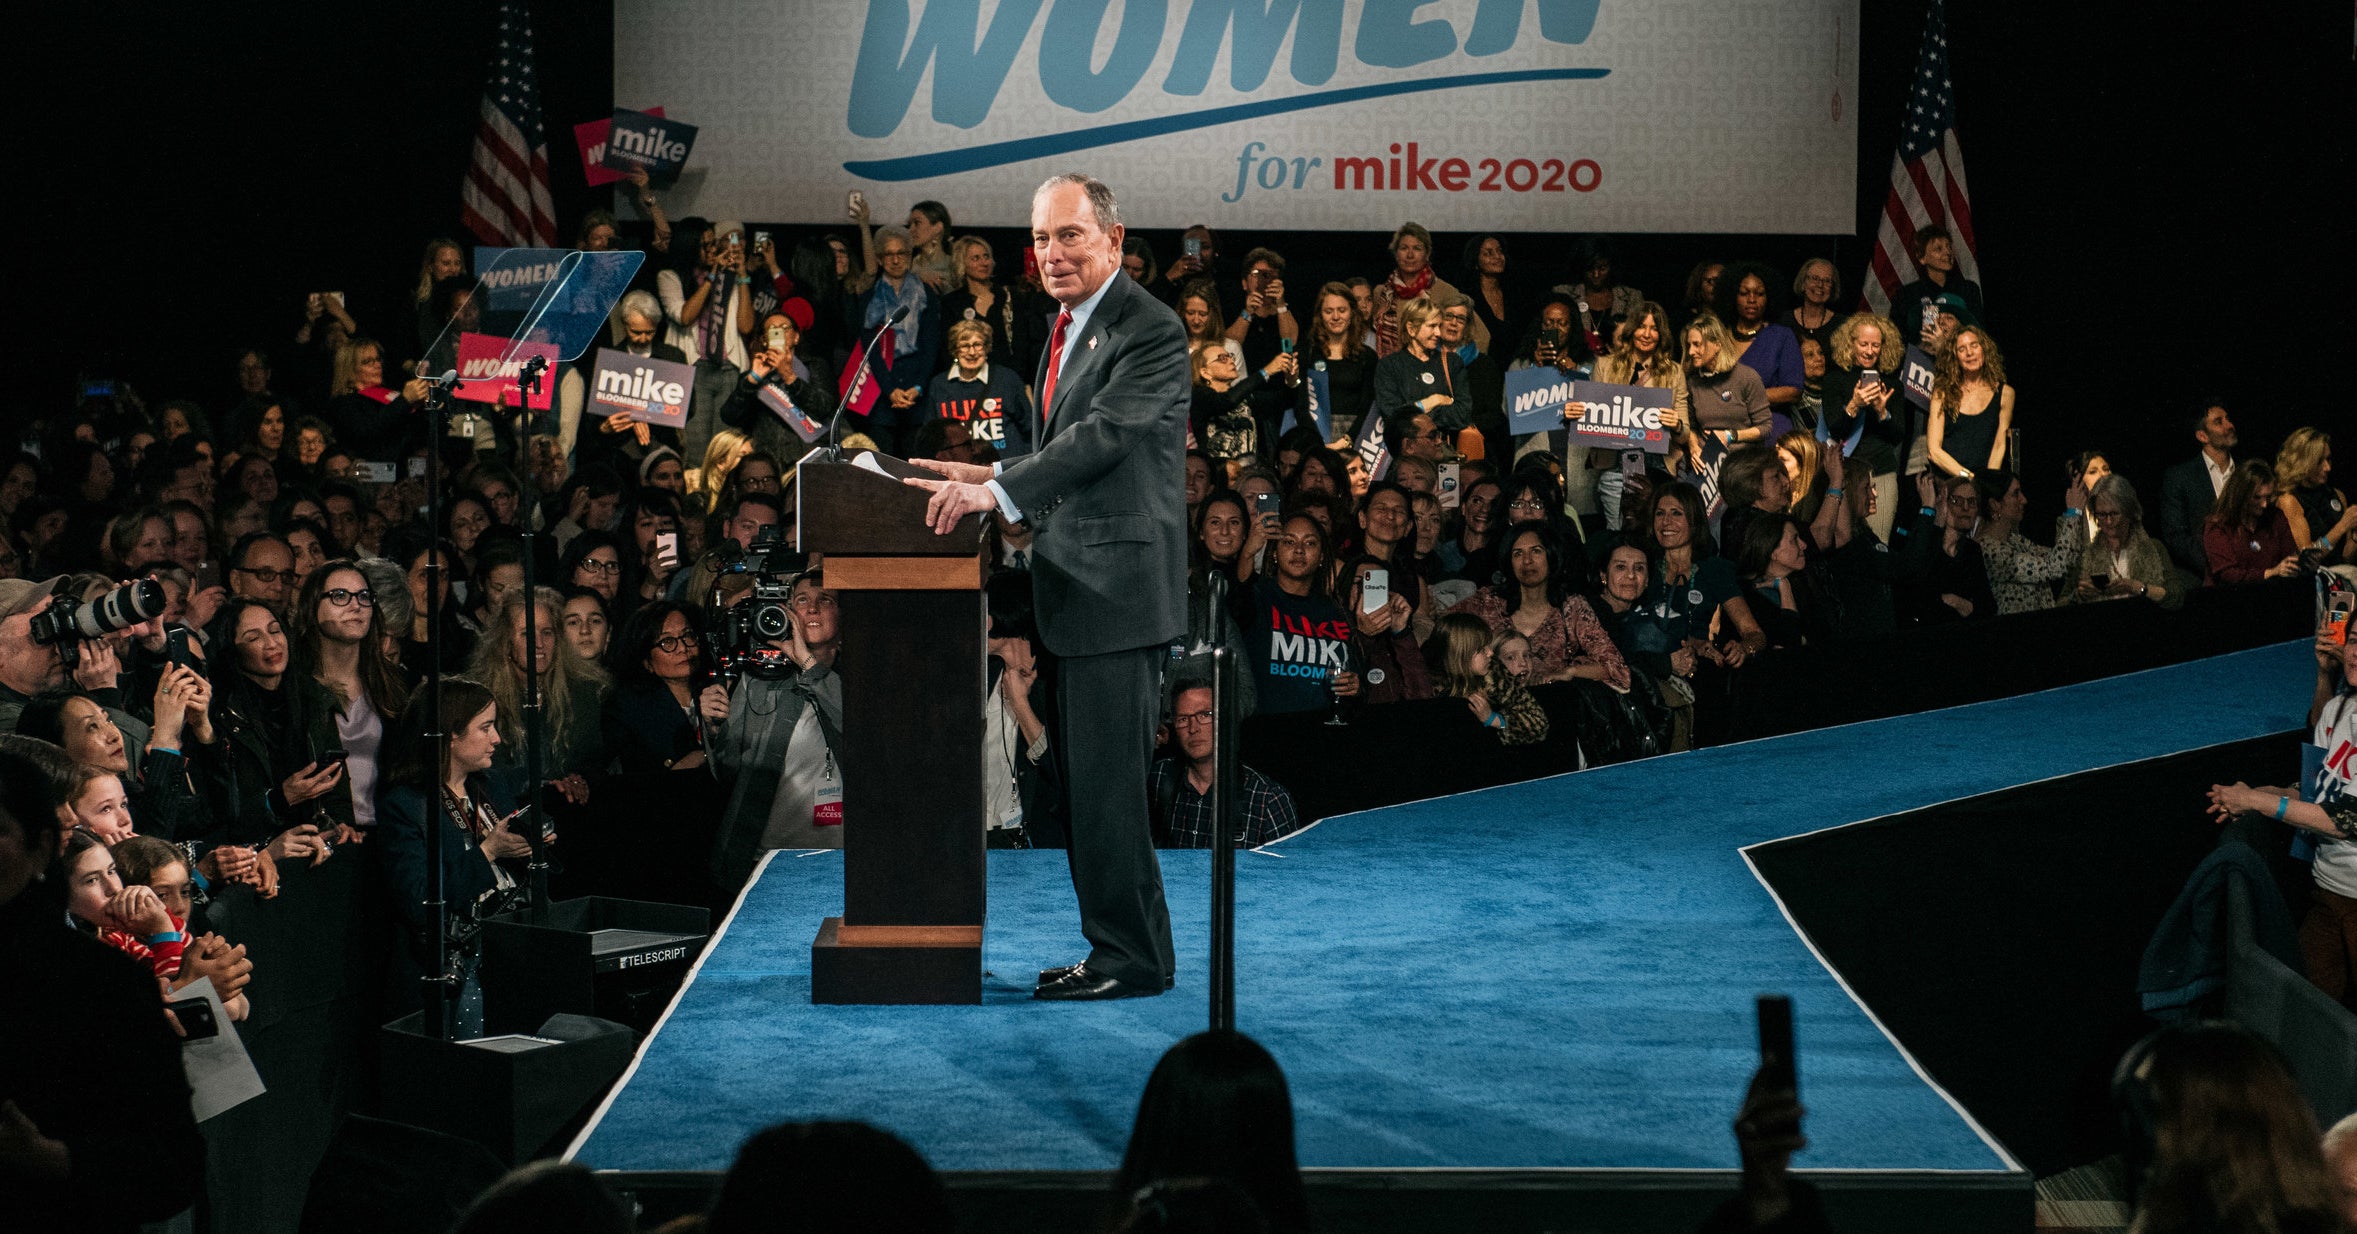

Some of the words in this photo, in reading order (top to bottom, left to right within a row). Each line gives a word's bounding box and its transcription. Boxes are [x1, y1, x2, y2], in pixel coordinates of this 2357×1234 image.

[613, 127, 686, 163] mike
[1222, 141, 1321, 203] for
[1334, 142, 1471, 190] mike
[1479, 158, 1602, 193] 2020
[482, 262, 561, 289] WOMEN
[463, 357, 552, 379] WOM
[598, 367, 685, 406] mike
[596, 391, 649, 409] BLOOMBERG
[1577, 395, 1664, 430] mike
[1577, 424, 1630, 436] BLOOMBERG
[1629, 429, 1663, 441] 2020
[1272, 604, 1280, 630] I
[1283, 614, 1351, 640] LIKE
[1270, 662, 1326, 680] BLOOM
[451, 809, 467, 829] EOS
[628, 946, 686, 967] TELESCRIPT
